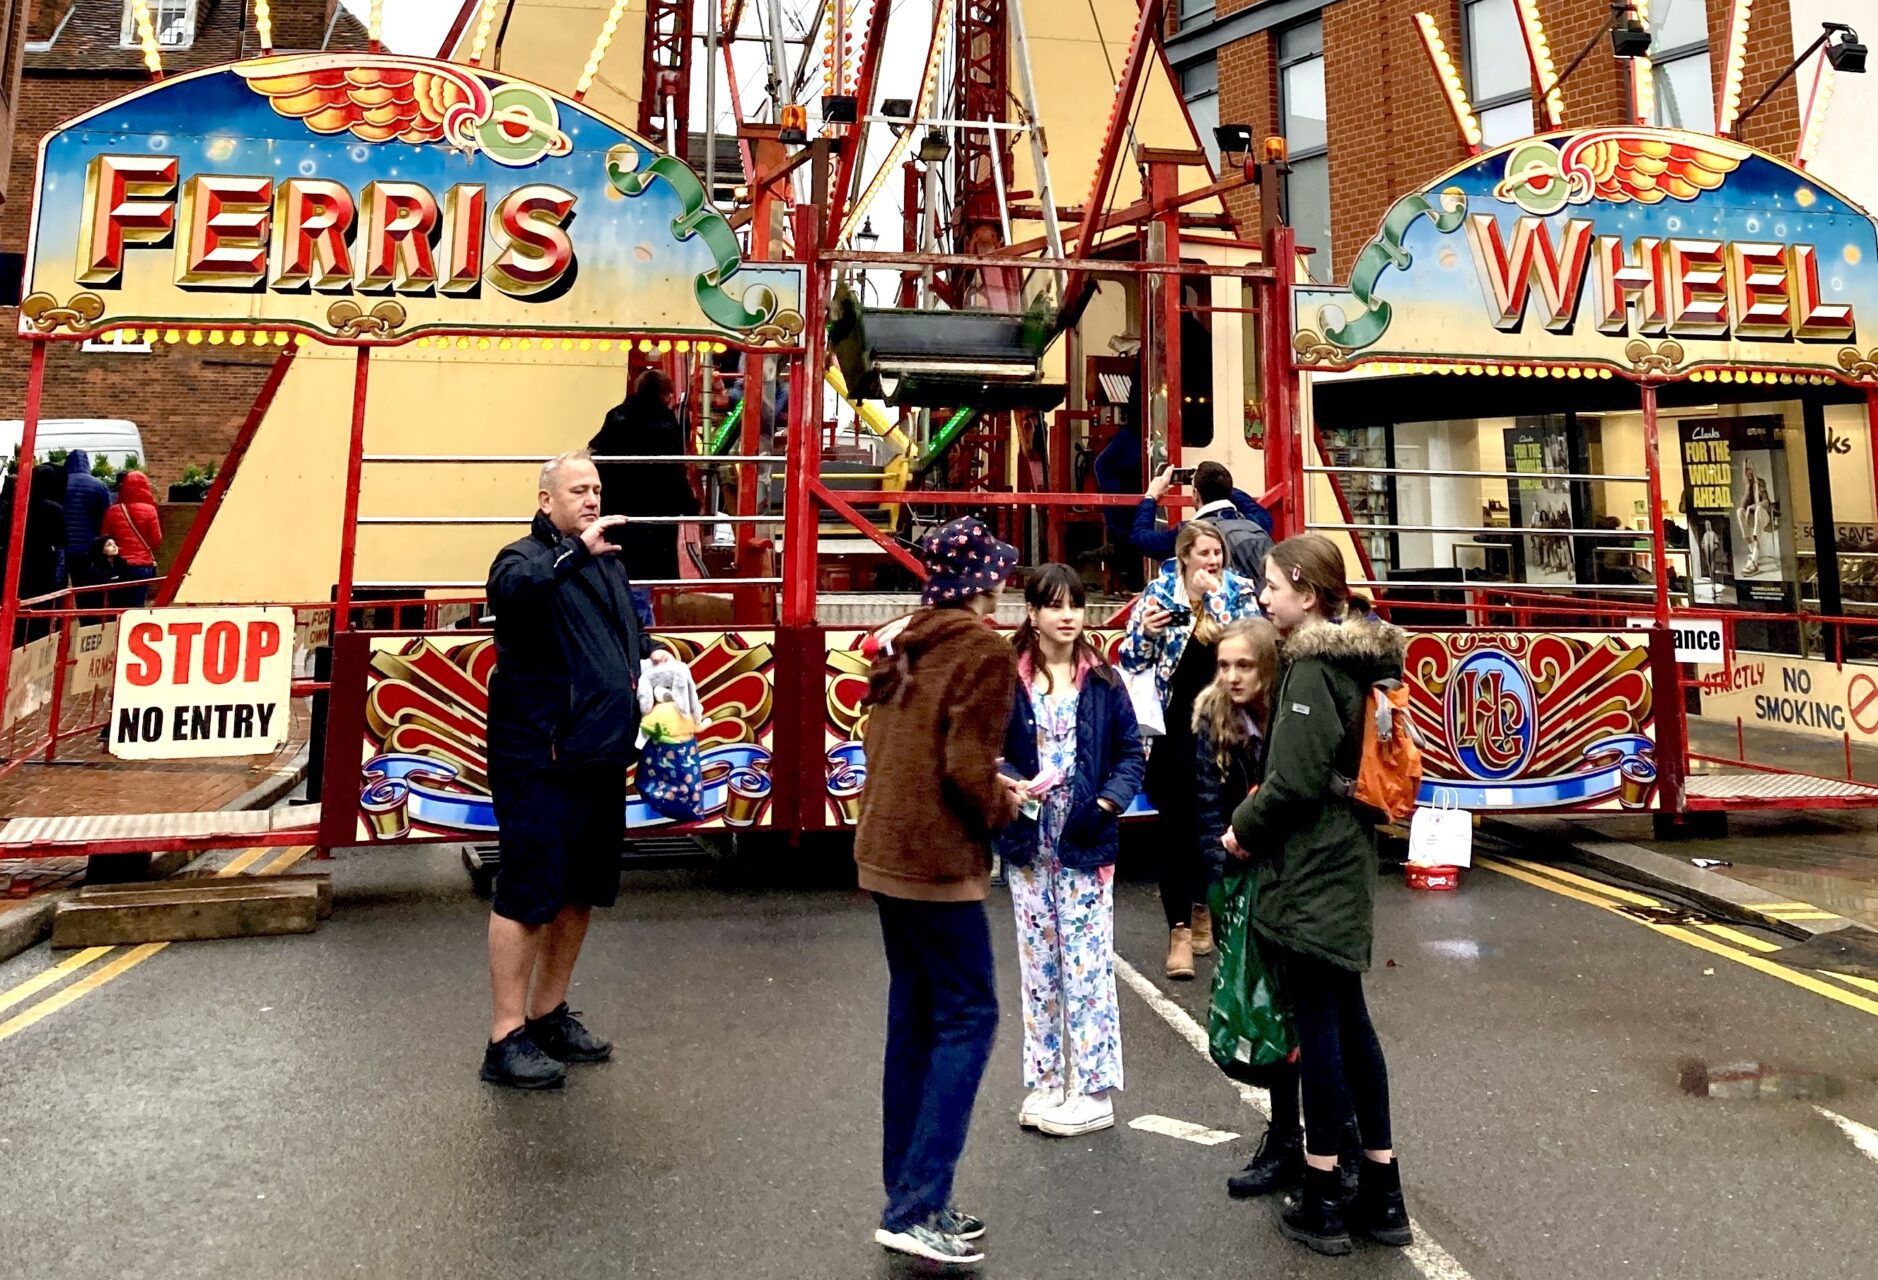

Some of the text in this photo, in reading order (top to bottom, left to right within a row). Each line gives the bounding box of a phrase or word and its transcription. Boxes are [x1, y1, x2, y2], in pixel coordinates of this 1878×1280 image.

[74, 153, 578, 297] FERRIS
[1465, 212, 1856, 339] WHEEL
[1692, 427, 1720, 440] Clarks
[1685, 440, 1731, 462] FOR THE
[1688, 464, 1731, 485] WORLD
[1693, 486, 1734, 508] AHEAD.
[80, 633, 103, 653] KEEP
[126, 621, 280, 686] STOP
[1783, 667, 1812, 694] NO
[117, 703, 277, 743] NO ENTRY
[1755, 694, 1846, 730] SMOKING
